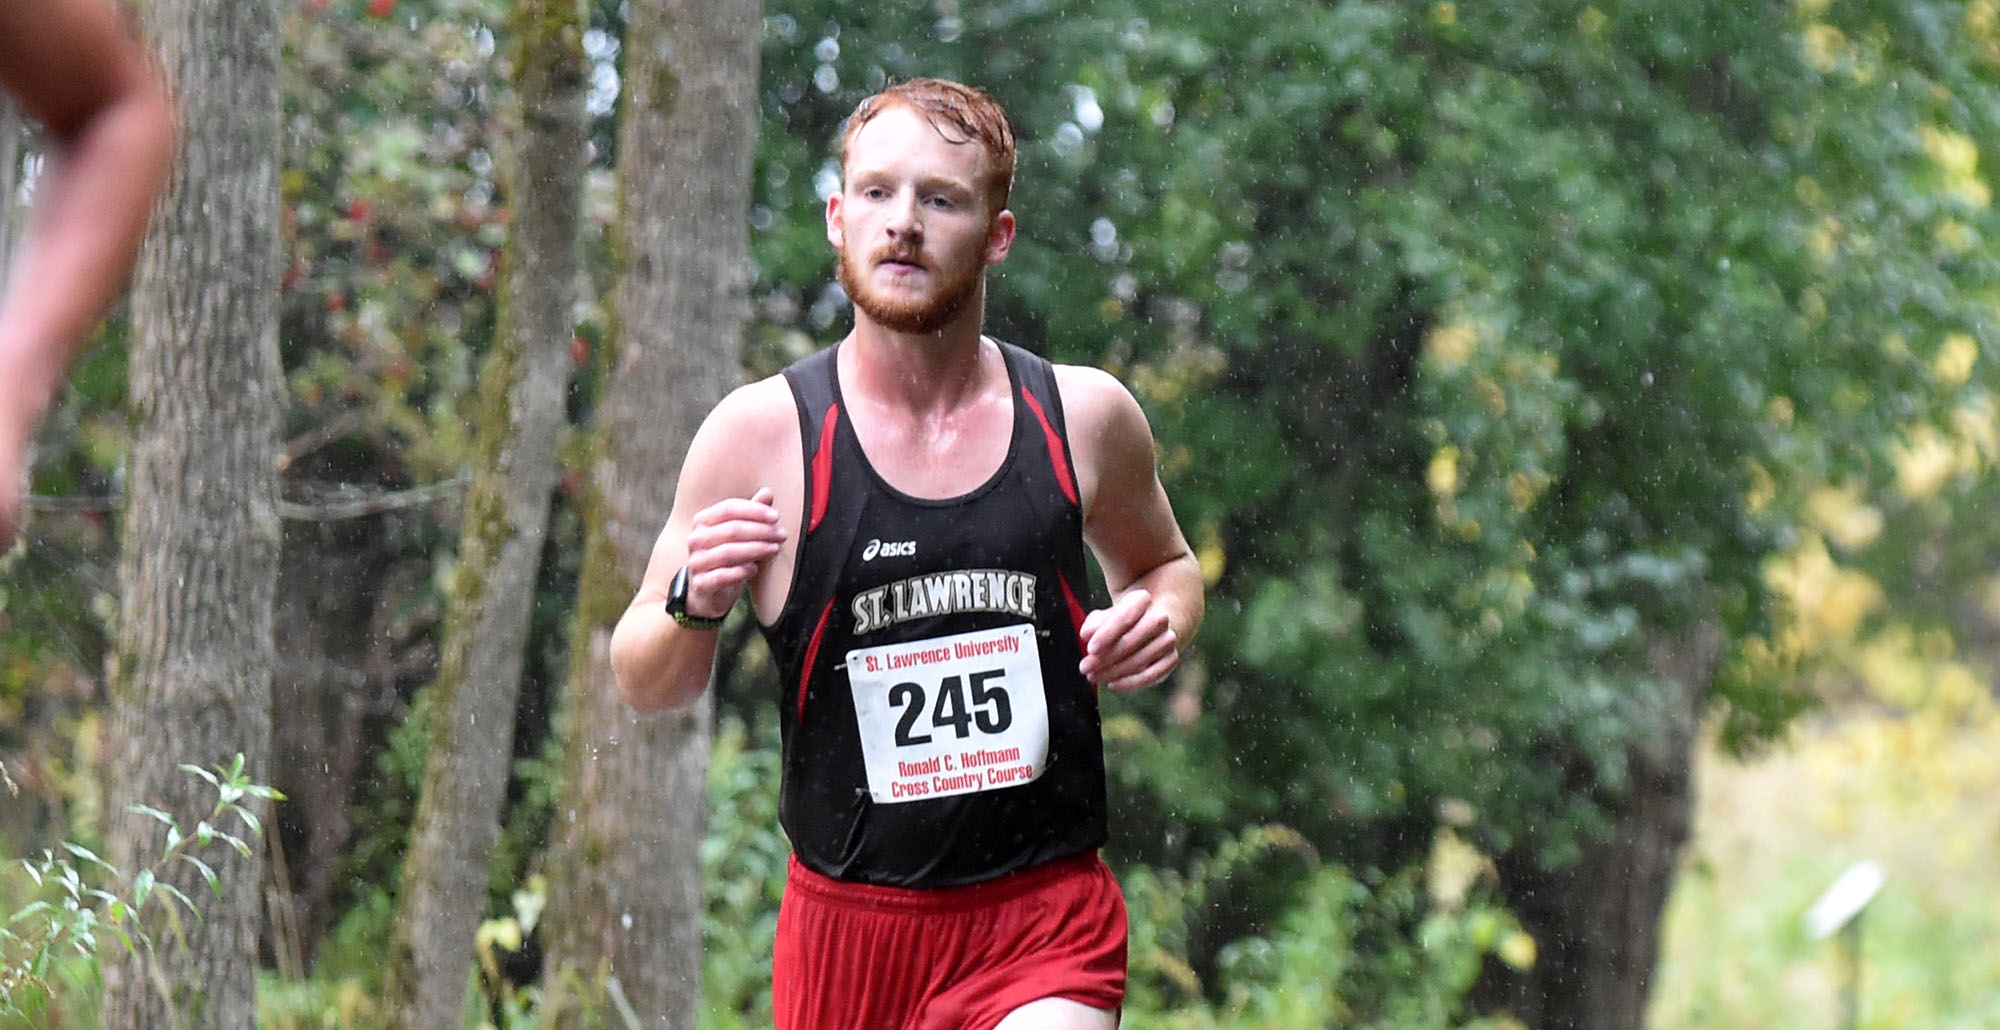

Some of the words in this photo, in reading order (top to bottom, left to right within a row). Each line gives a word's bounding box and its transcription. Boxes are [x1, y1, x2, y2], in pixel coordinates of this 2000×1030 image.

[880, 540, 916, 557] asics
[852, 584, 892, 635] ST.
[892, 568, 1037, 621] LAWRENCE
[865, 655, 884, 672] St.
[886, 646, 951, 670] Lawrence
[954, 635, 1019, 660] University
[888, 668, 1012, 747] 245
[898, 754, 940, 777] Ronald
[944, 754, 958, 772] C.
[960, 747, 1020, 769] Hoffmann
[891, 778, 929, 798] Cross
[933, 771, 983, 793] Country
[987, 763, 1033, 784] Course
